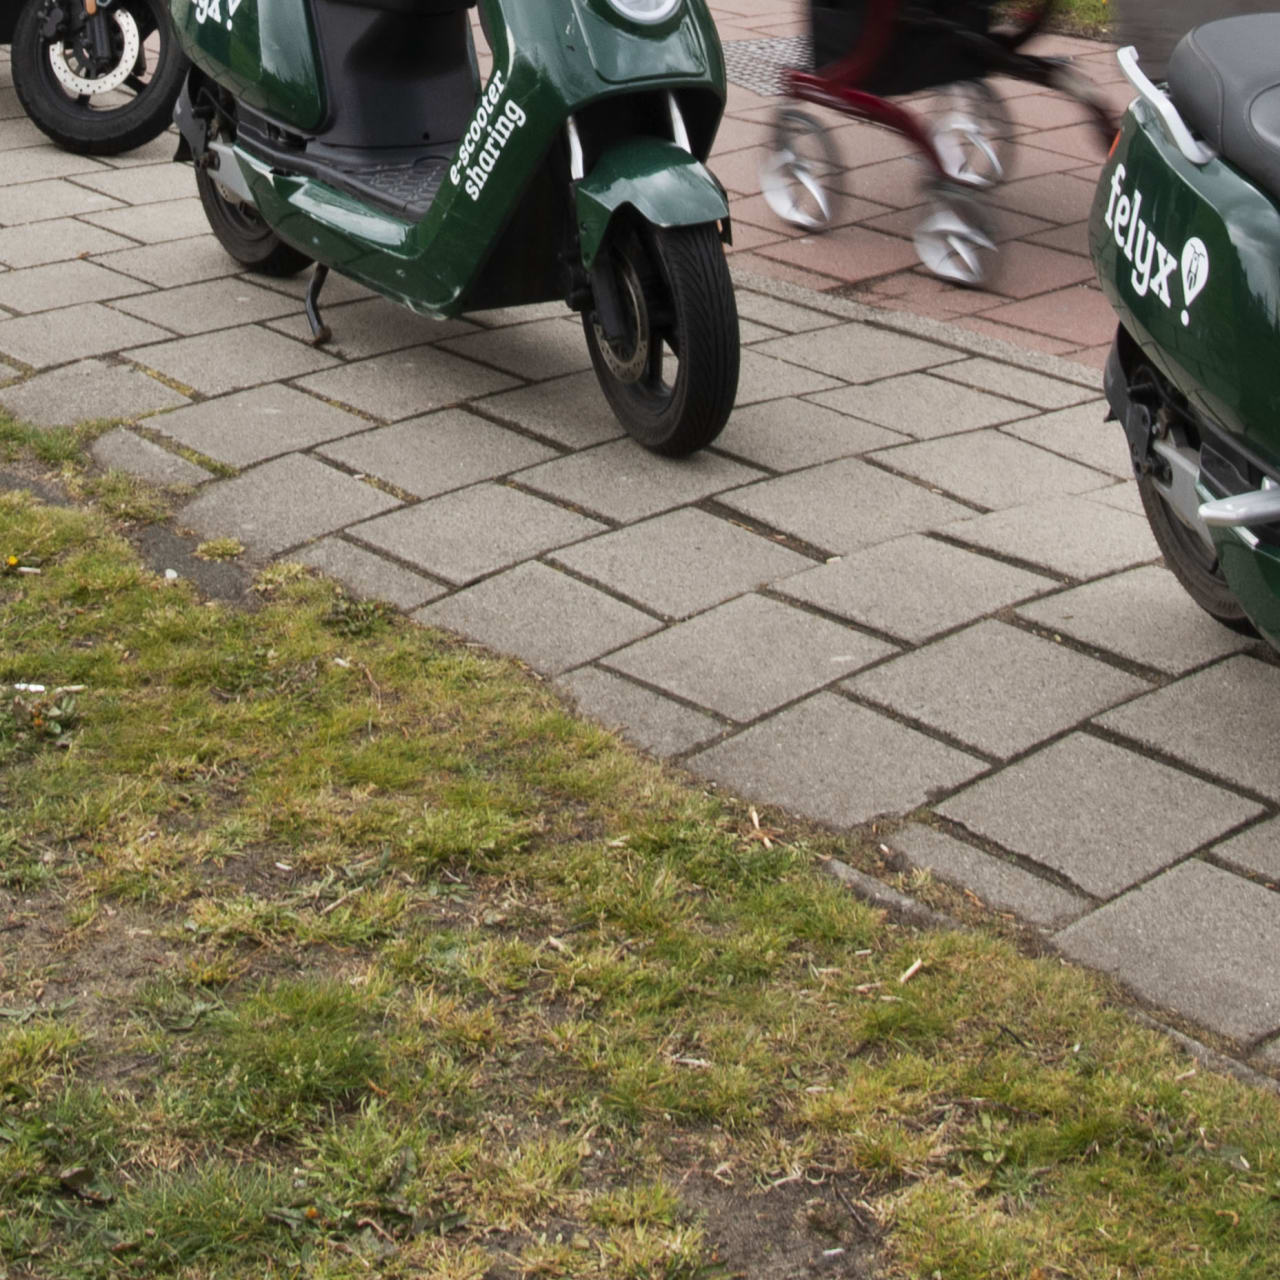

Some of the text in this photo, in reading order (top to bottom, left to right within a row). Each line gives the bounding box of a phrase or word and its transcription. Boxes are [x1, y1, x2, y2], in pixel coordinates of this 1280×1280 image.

[449, 70, 505, 186] e-scooter
[464, 98, 527, 201] sharing
[1104, 162, 1178, 309] felyx
